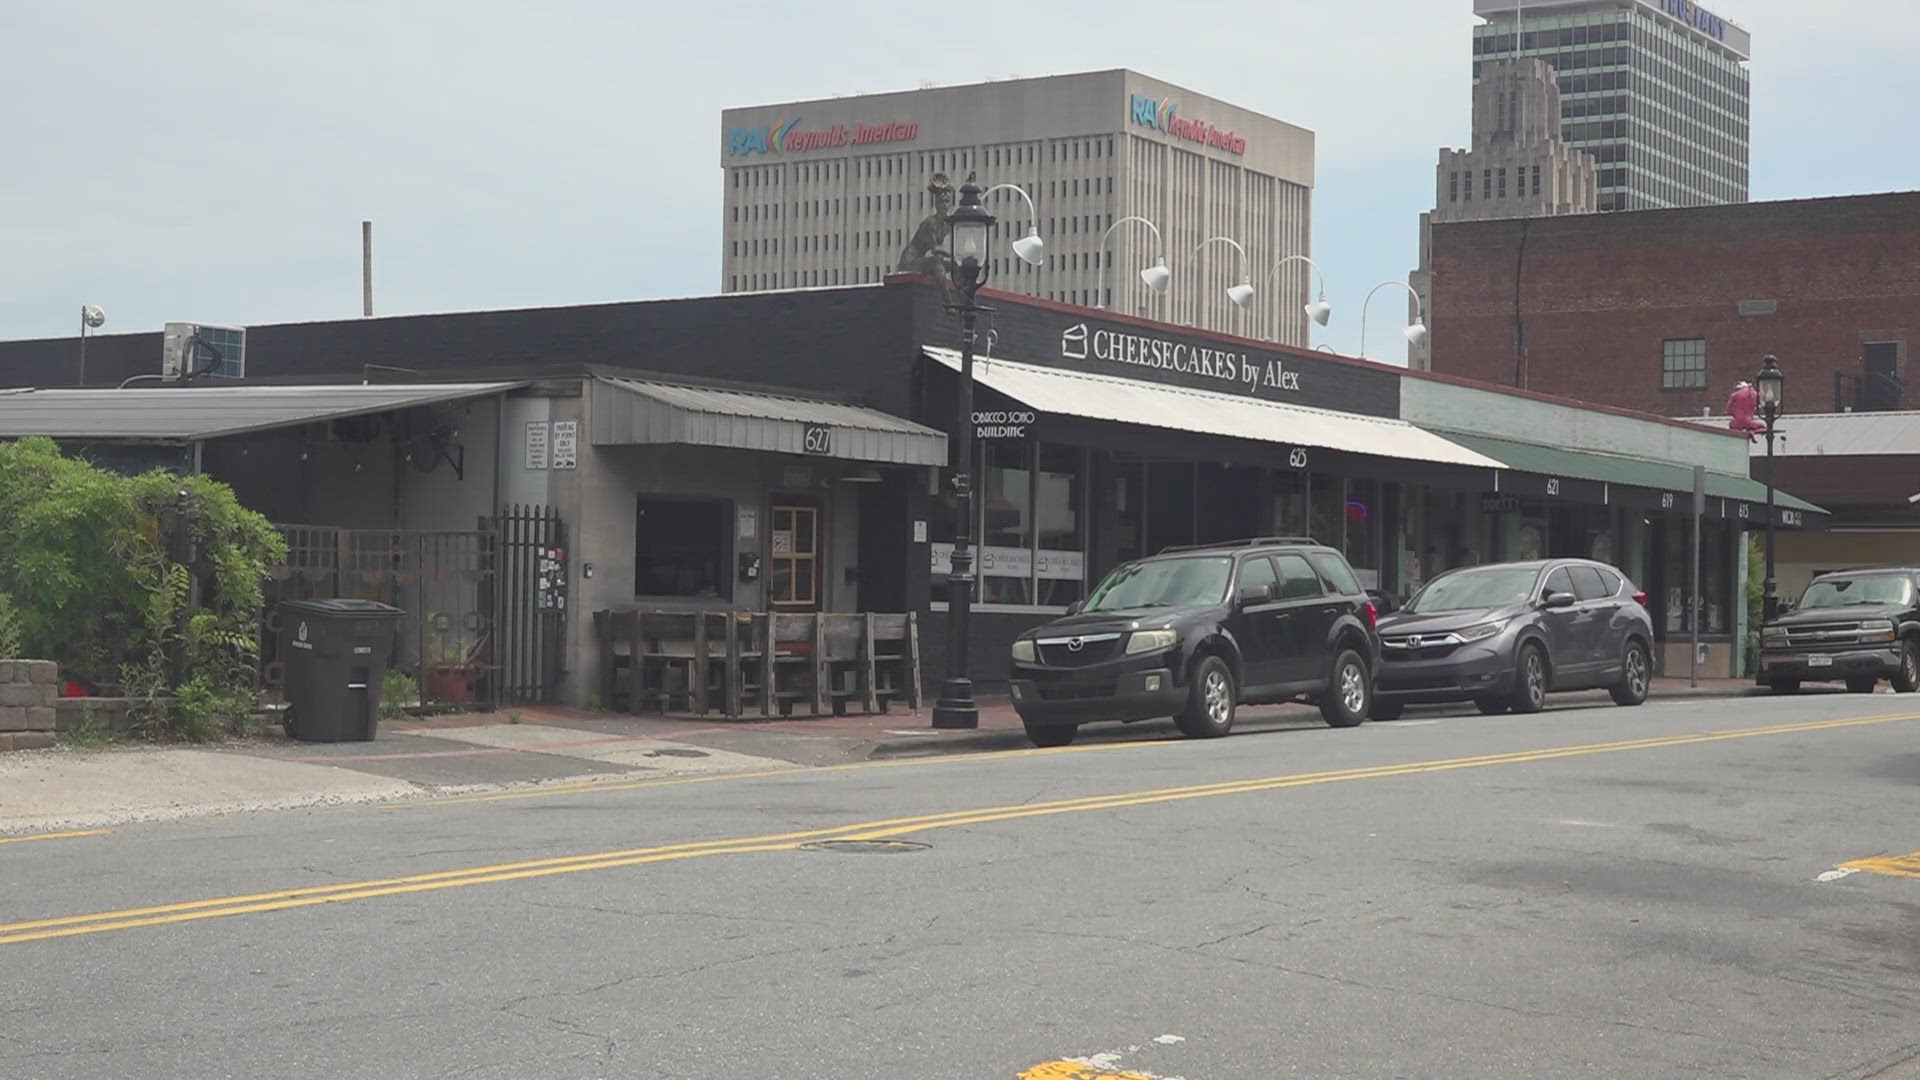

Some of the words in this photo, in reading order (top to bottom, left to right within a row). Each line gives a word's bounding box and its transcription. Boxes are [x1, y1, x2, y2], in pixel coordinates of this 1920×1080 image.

[787, 125, 848, 152] Reynolds
[852, 120, 918, 146] American
[1167, 111, 1207, 145] Reynolds
[1206, 124, 1246, 156] American
[1093, 329, 1236, 381] CHEESECAKES
[1242, 354, 1260, 393] by
[1263, 360, 1300, 391] Alex
[971, 411, 1007, 424] OBACCO
[1008, 411, 1035, 424] SOHO
[805, 427, 831, 452] 627
[977, 426, 1025, 438] BUILDING
[1290, 447, 1307, 468] 625
[1547, 478, 1559, 496] 621
[1662, 493, 1673, 509] 619
[1739, 503, 1749, 519] 615
